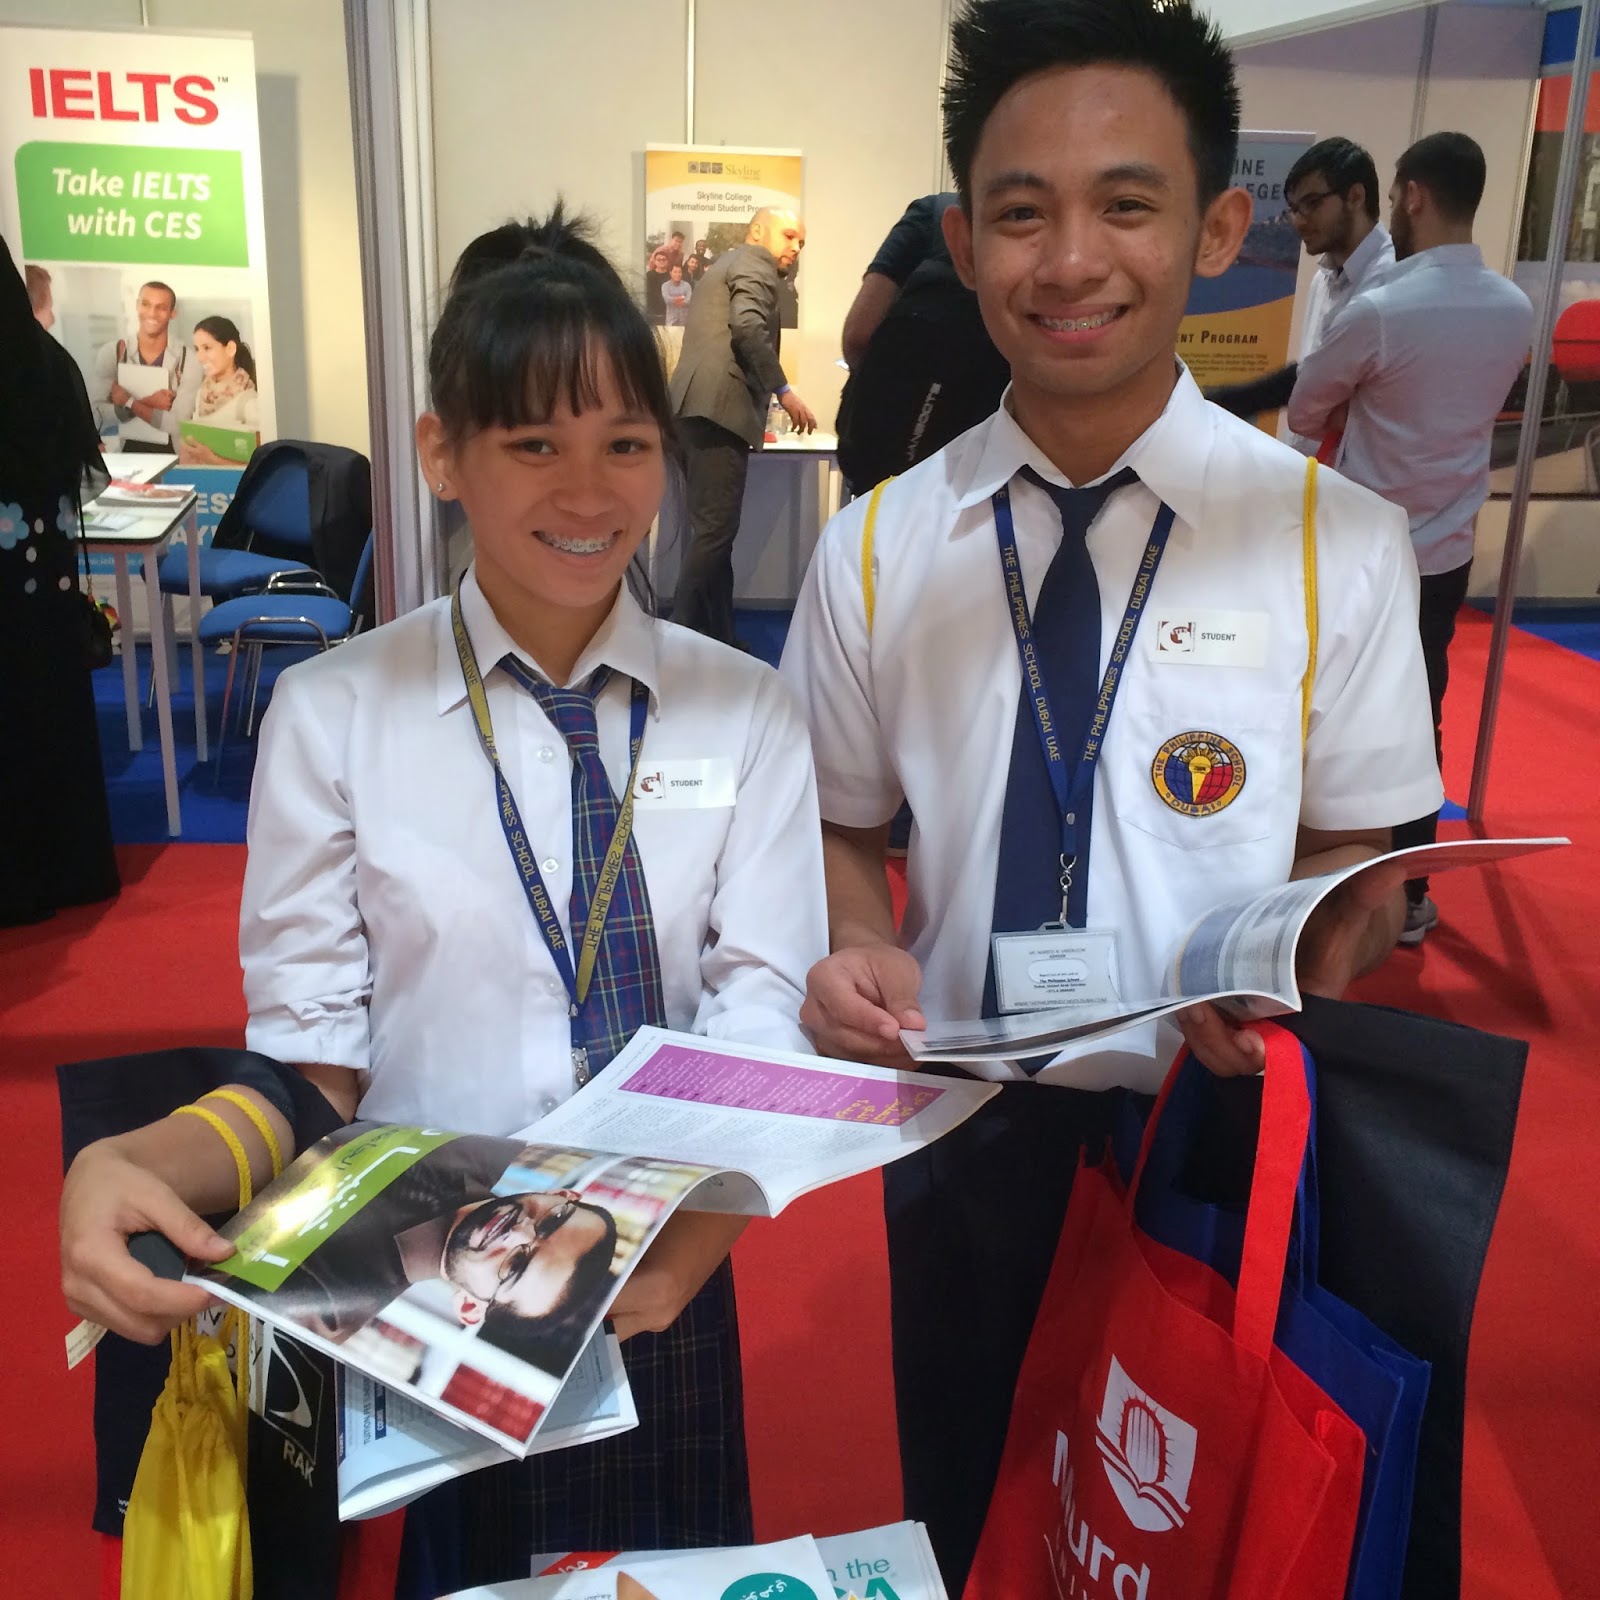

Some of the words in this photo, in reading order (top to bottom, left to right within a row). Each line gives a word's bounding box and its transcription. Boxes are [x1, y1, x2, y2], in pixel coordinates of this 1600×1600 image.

[29, 68, 219, 126] IELTS
[52, 167, 125, 198] Take
[132, 171, 211, 201] IELTS
[697, 191, 723, 201] Skyline
[725, 192, 752, 203] College
[67, 207, 136, 238] with
[144, 211, 203, 240] CES
[671, 202, 716, 212] International
[717, 203, 745, 212] Student
[1003, 544, 1017, 568] THE
[1144, 544, 1161, 570] UAE
[1008, 570, 1030, 640] PHILIPPINES
[1130, 573, 1151, 610] DUBAI
[1113, 613, 1138, 663] SCHOOL
[1201, 632, 1237, 641] STUDENT
[1023, 643, 1042, 693] SCHOOL
[1035, 696, 1053, 734] DUBAI
[1090, 666, 1119, 738] PHILIPPINES
[1046, 735, 1061, 762] UAE
[1083, 739, 1099, 762] THE
[1155, 758, 1166, 779] THE
[1163, 733, 1223, 755] PHILIPPINE
[1225, 747, 1243, 787] SCHOOL
[670, 779, 704, 787] STUDENT
[1171, 800, 1217, 814] DUBAI
[510, 830, 532, 883] SCHOOL
[529, 884, 553, 924] DUBAI
[546, 924, 567, 951] UAE
[283, 1439, 315, 1488] RAK
[845, 1558, 890, 1580] the
